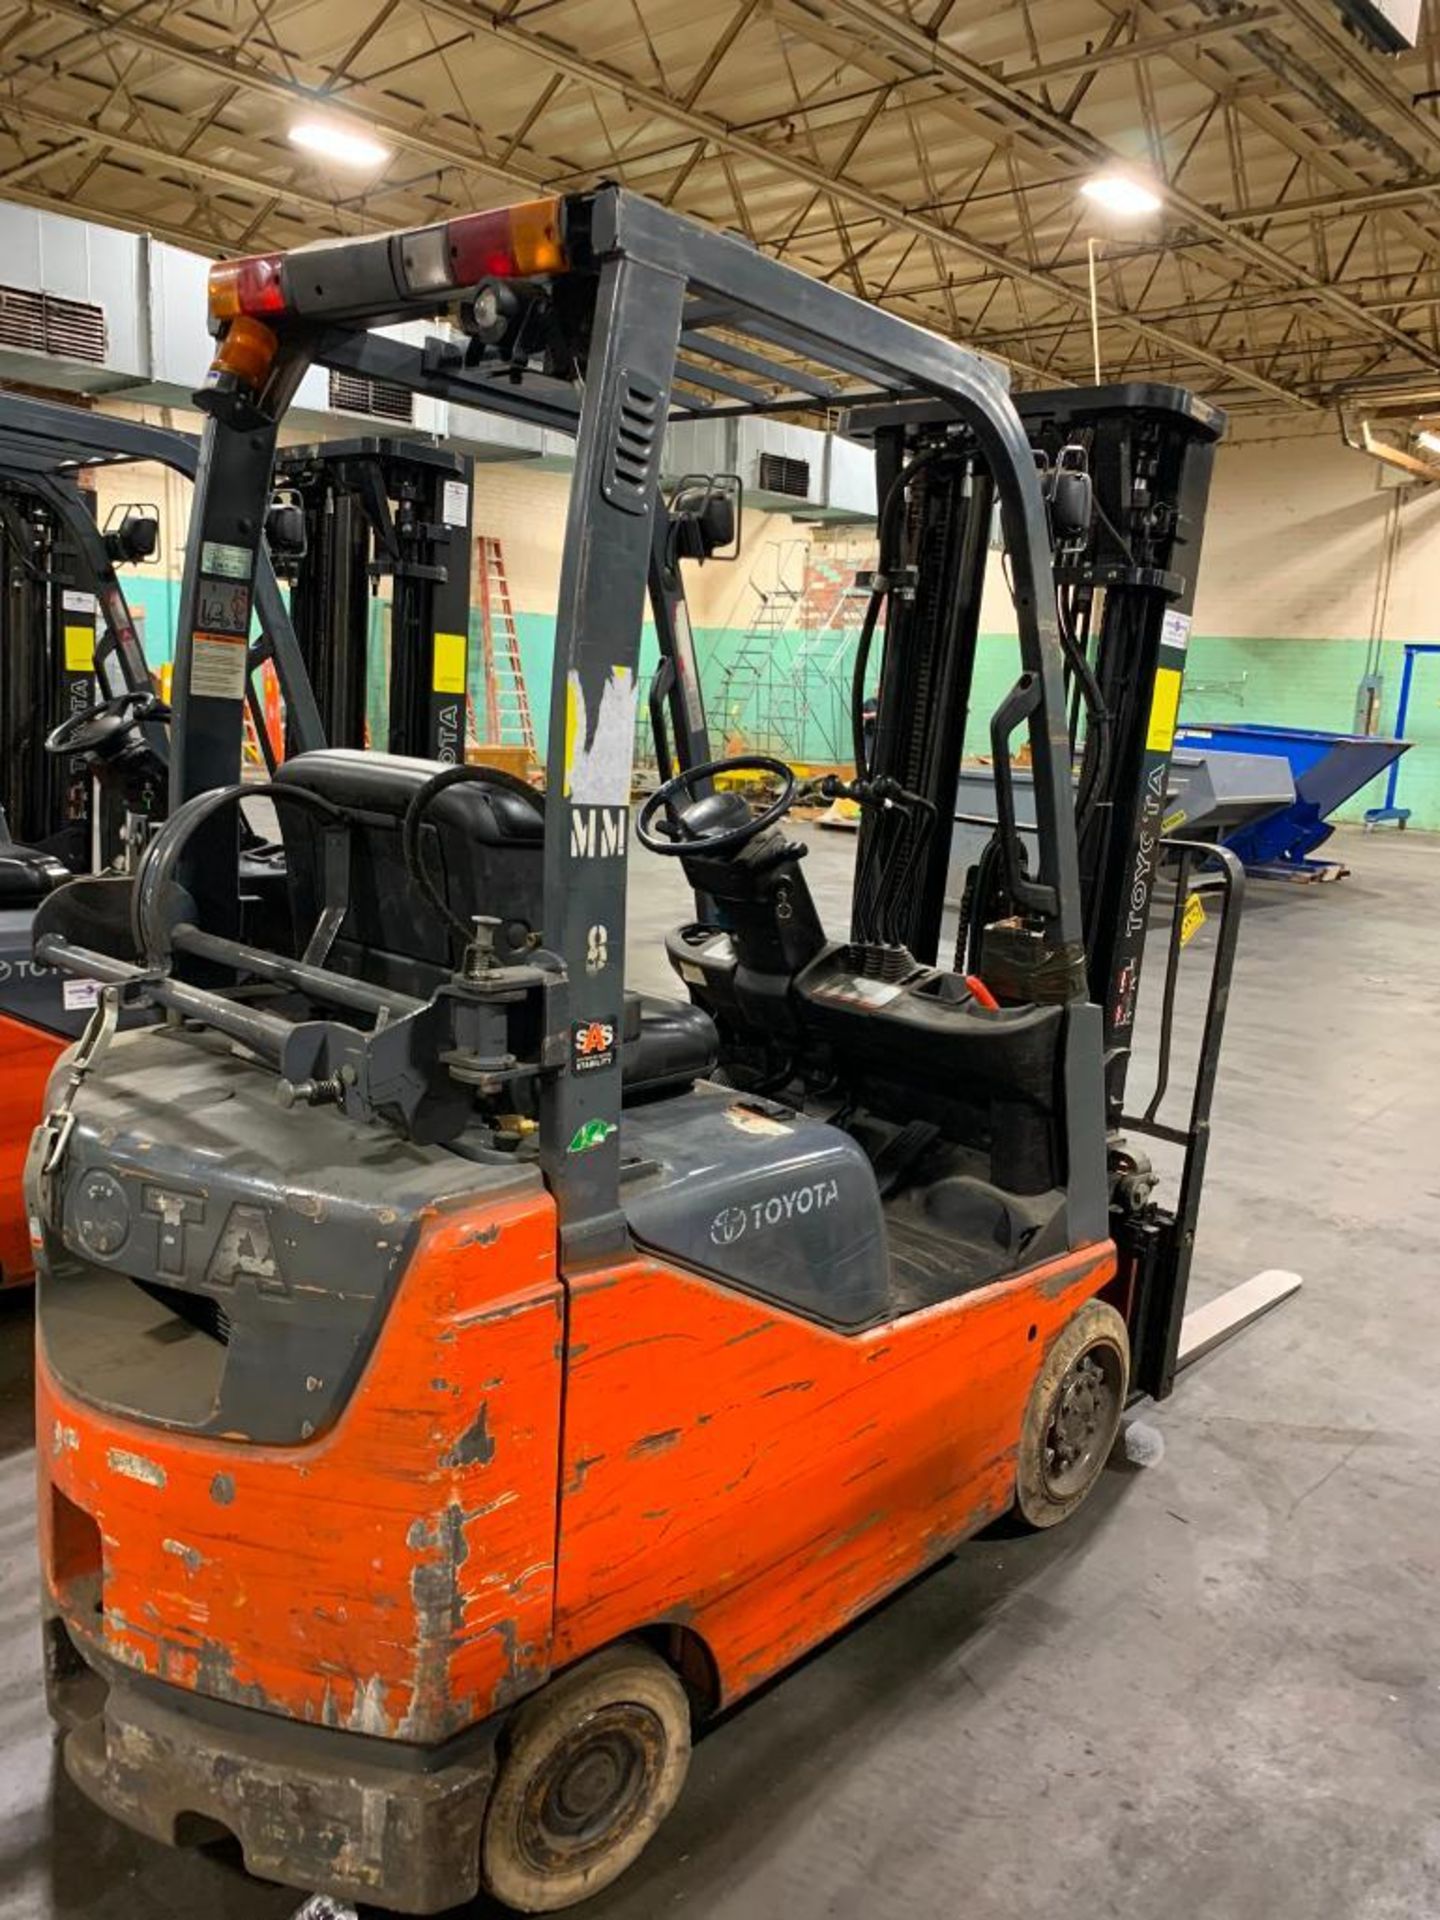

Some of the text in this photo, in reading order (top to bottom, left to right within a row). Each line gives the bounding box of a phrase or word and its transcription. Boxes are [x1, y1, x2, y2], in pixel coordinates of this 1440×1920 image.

[571, 809, 626, 858] MM
[586, 924, 608, 976] 8
[575, 1022, 613, 1055] SAS
[751, 1179, 839, 1230] TOYOTA
